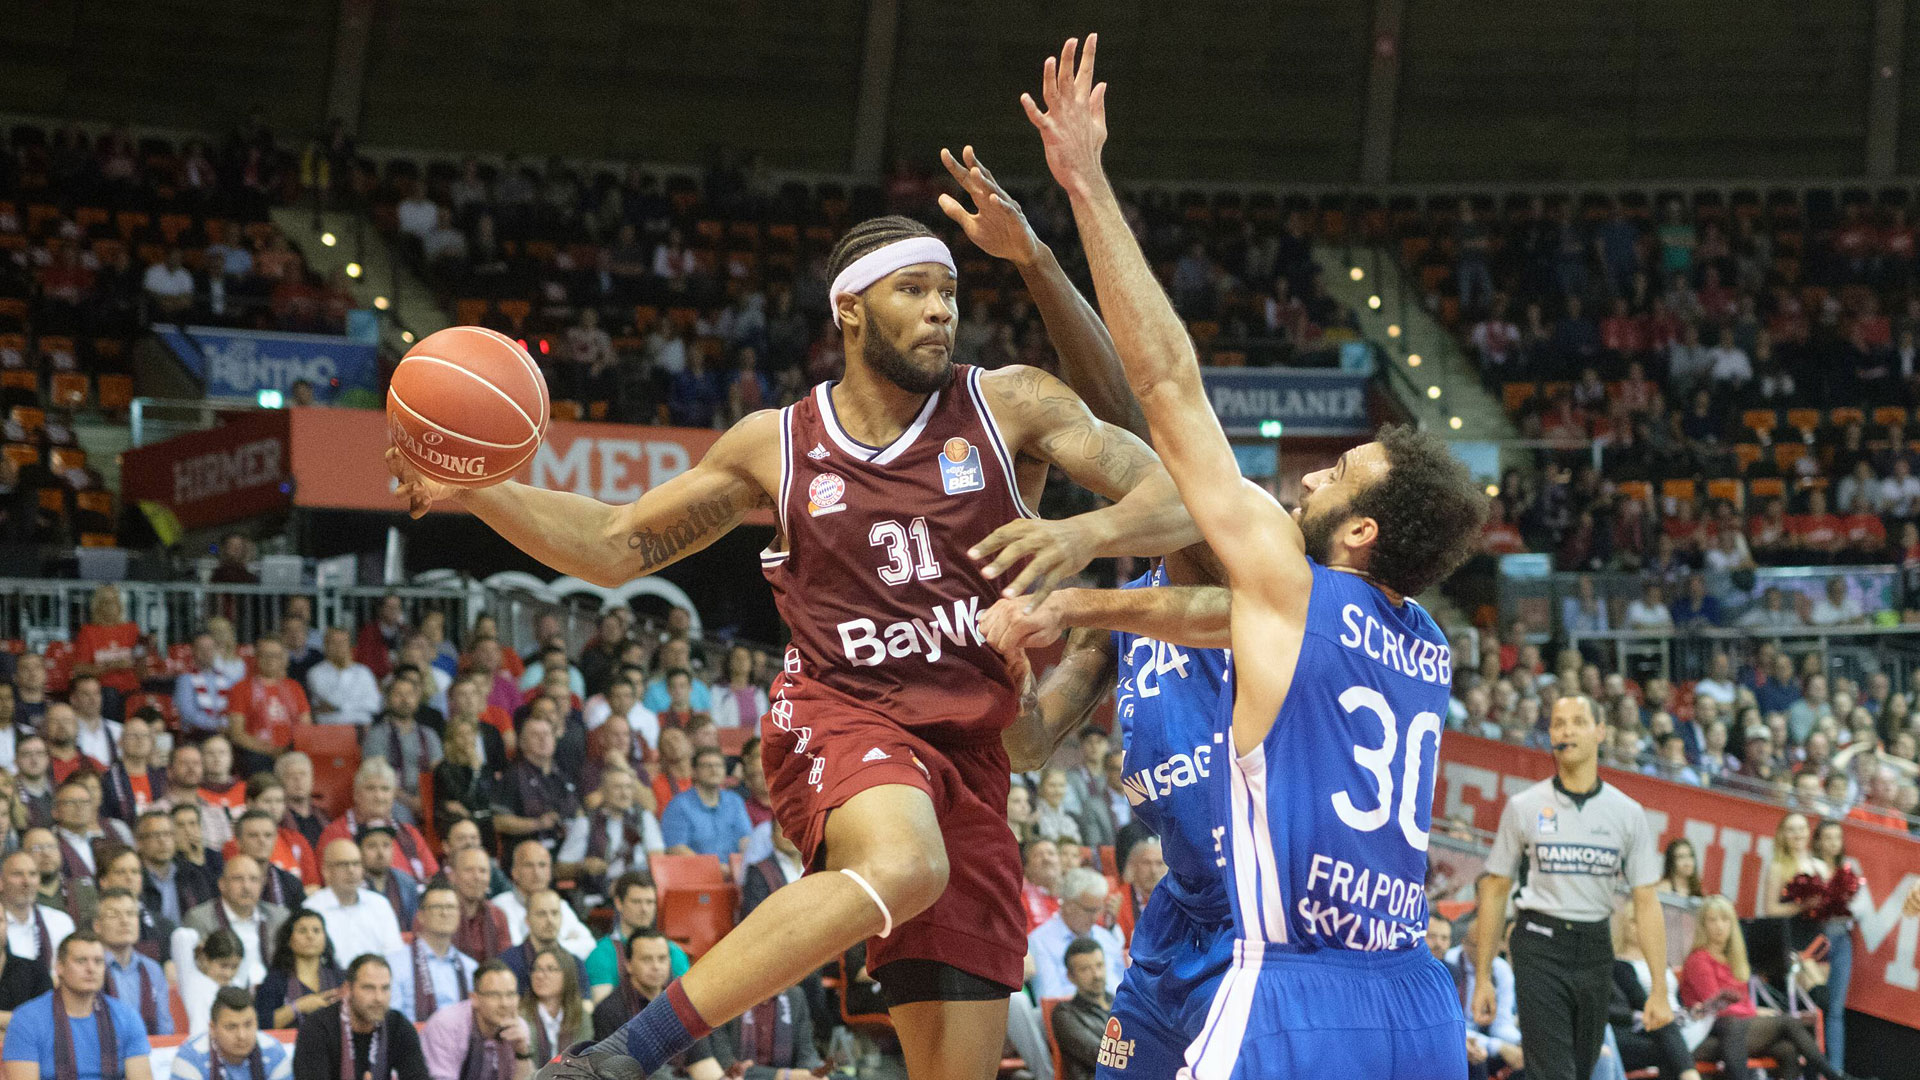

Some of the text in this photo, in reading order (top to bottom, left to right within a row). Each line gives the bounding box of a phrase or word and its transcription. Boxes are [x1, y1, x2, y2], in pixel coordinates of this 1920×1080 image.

[1213, 387, 1365, 417] PAULANER
[949, 474, 979, 490] BBL
[868, 516, 942, 586] 31
[837, 596, 988, 667] BayW
[1340, 603, 1452, 685] SCRUBB
[1131, 636, 1190, 698] 24
[1331, 685, 1442, 852] 30
